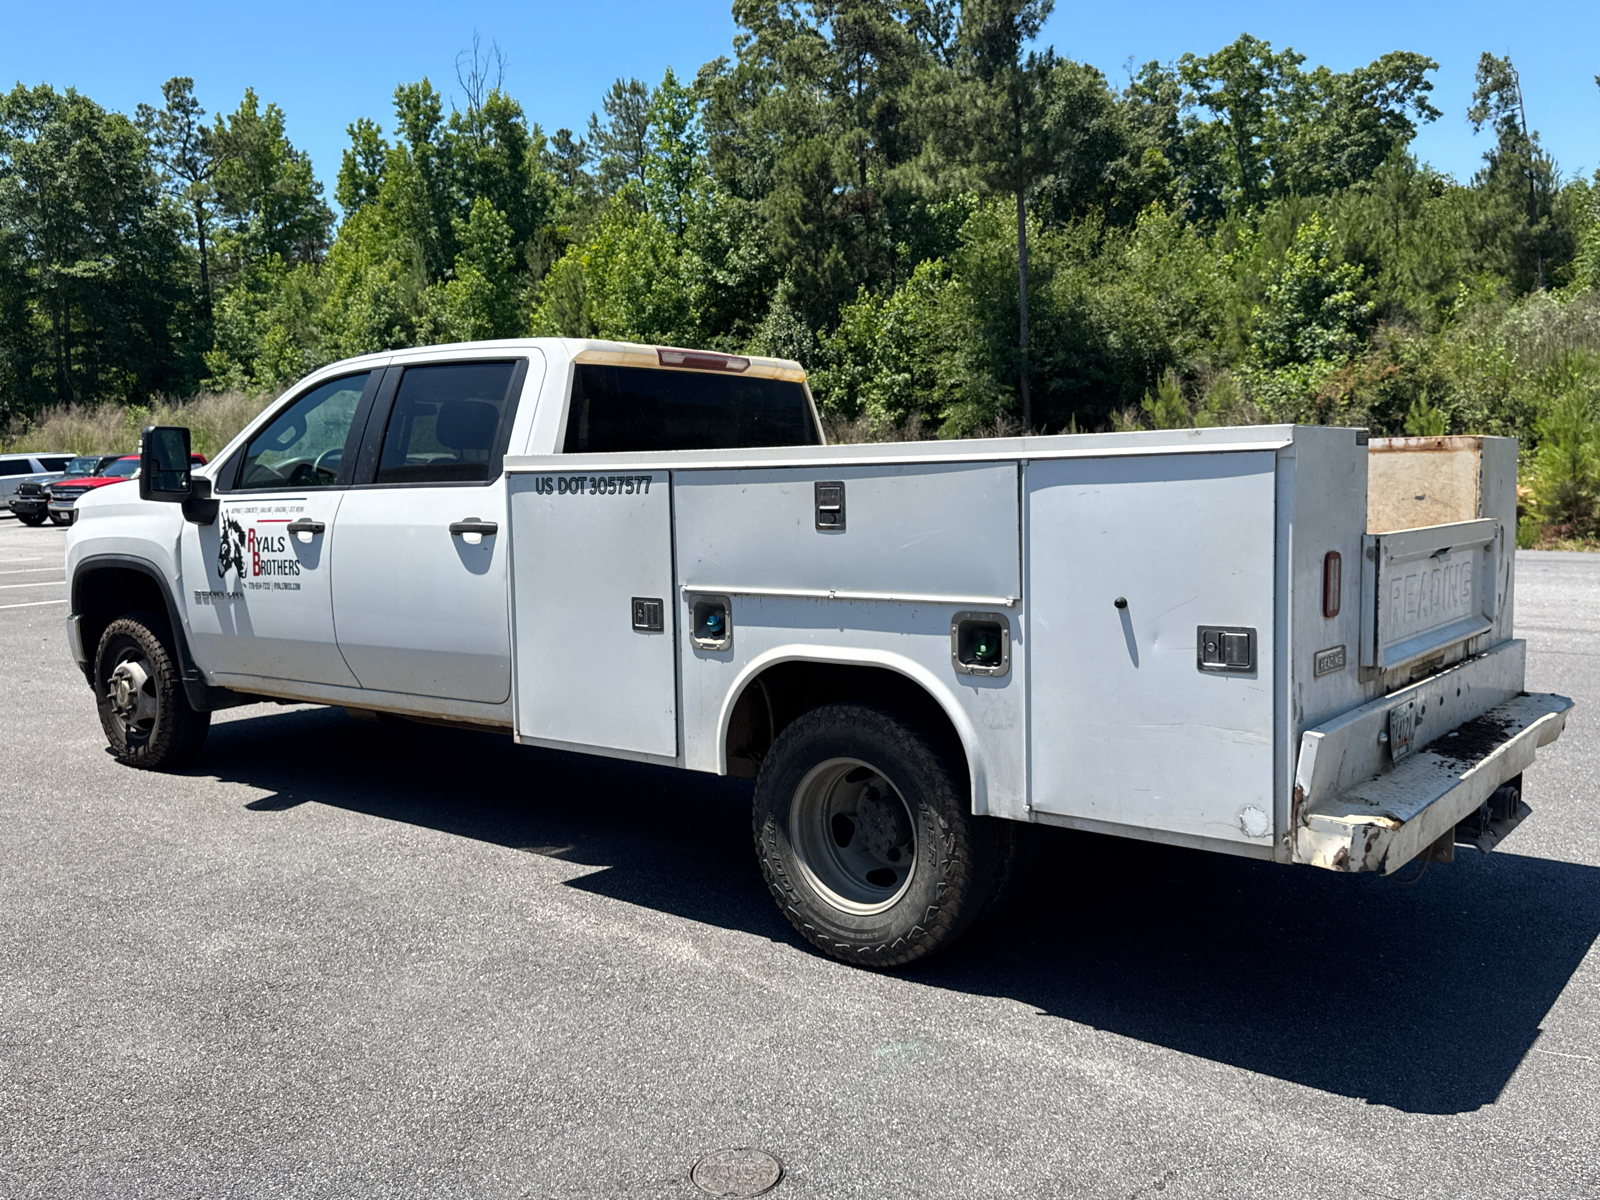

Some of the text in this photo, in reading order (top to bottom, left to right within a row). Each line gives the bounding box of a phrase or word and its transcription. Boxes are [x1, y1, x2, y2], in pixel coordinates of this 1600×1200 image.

[535, 475, 652, 495] US DOT 3057577
[247, 528, 285, 553] RYALS
[252, 552, 300, 577] BROTHERS
[1389, 561, 1472, 625] READING
